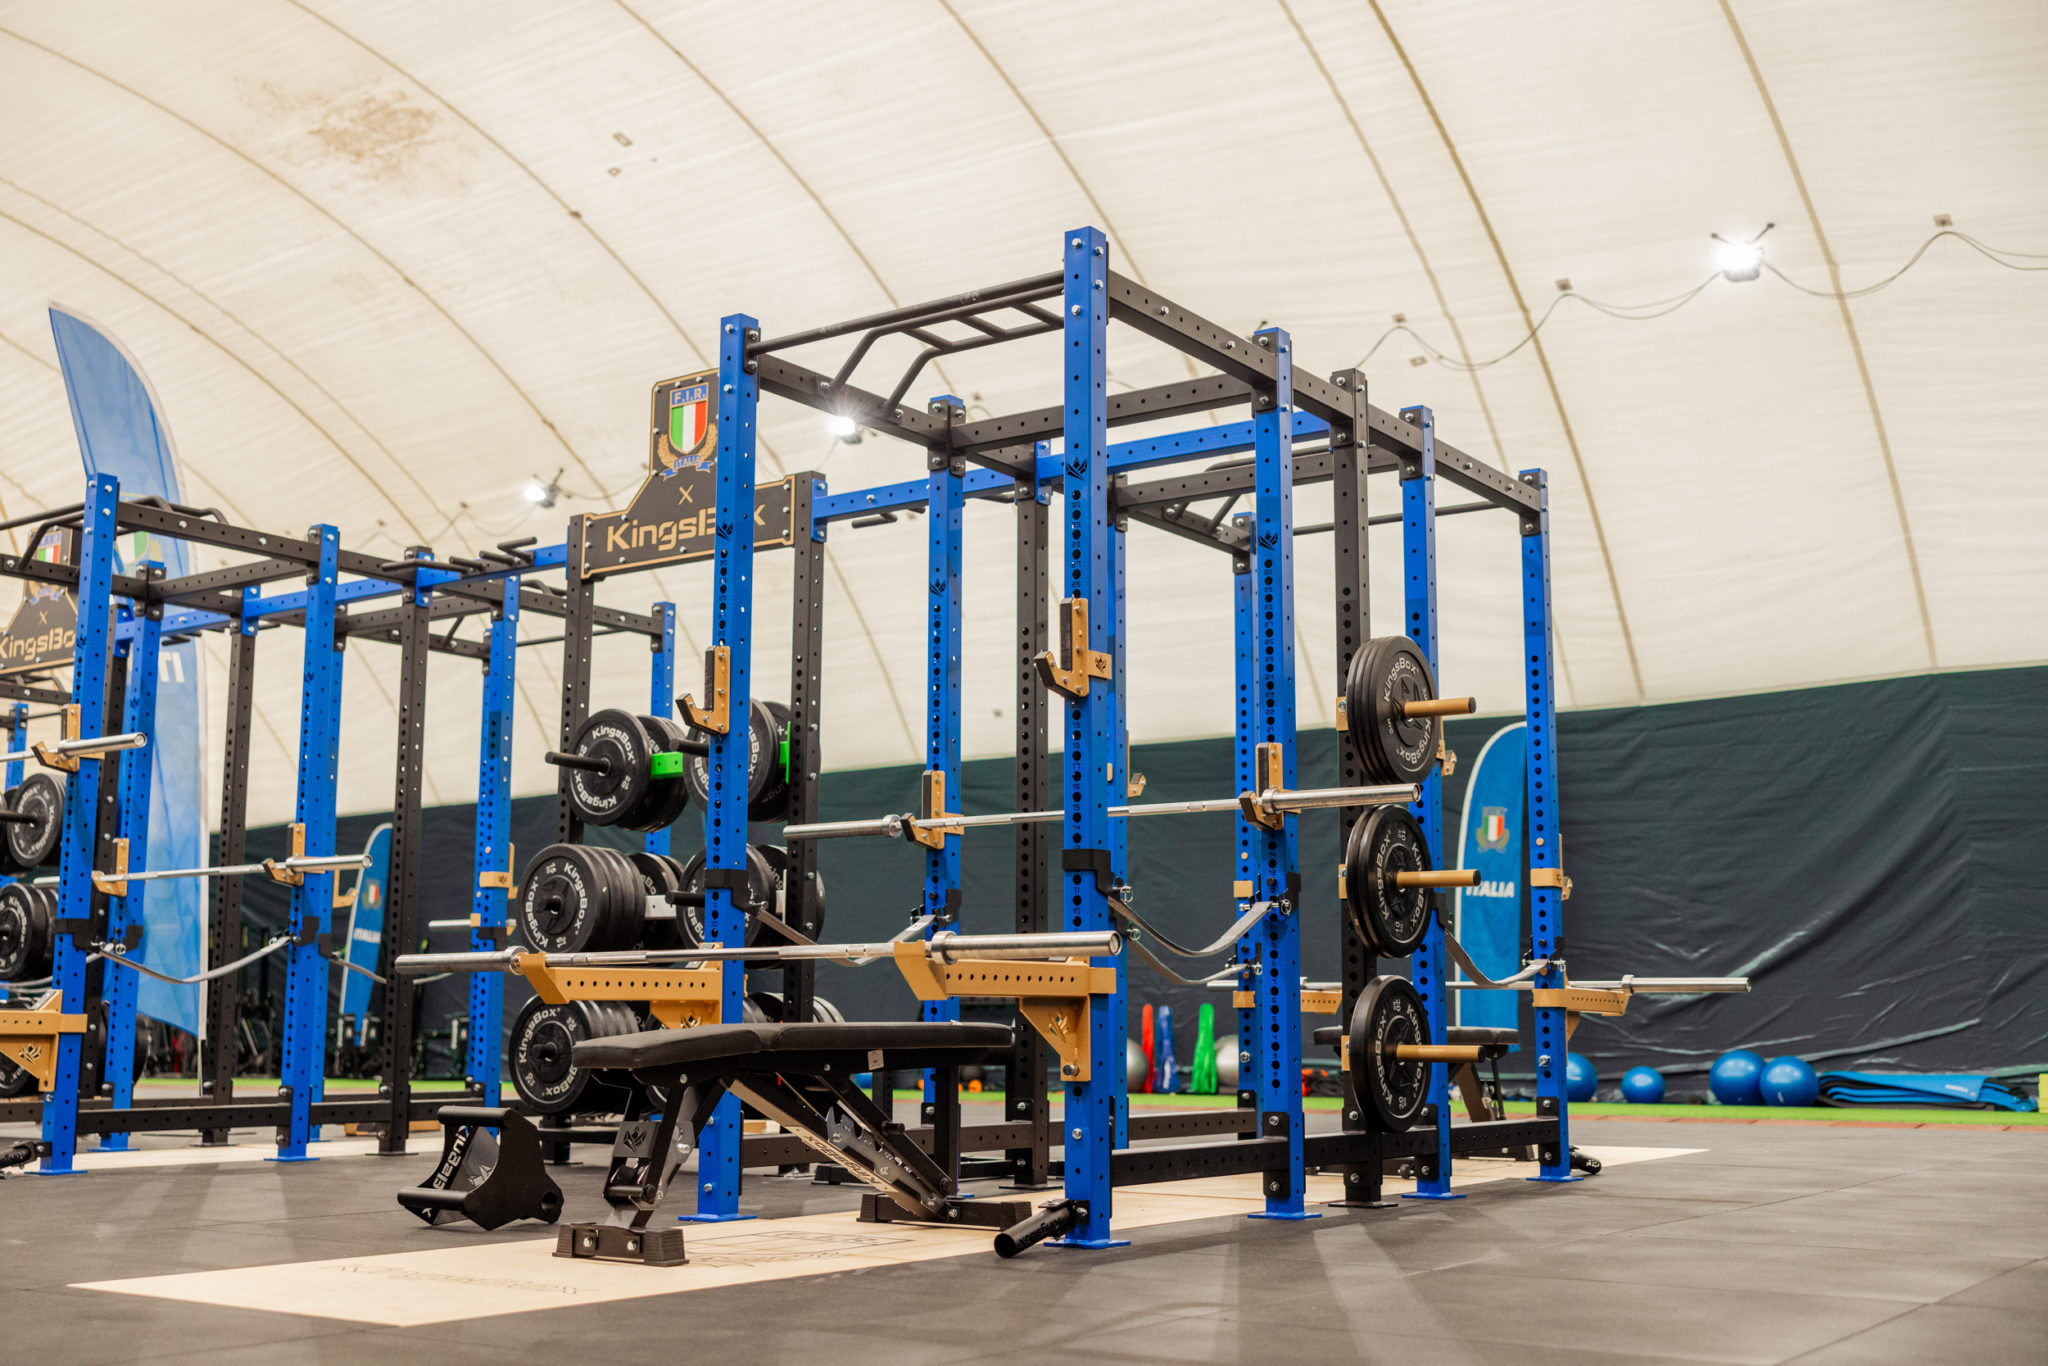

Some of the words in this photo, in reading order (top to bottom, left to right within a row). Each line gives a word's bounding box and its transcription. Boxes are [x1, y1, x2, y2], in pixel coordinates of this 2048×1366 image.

[674, 387, 707, 404] F.I.R.
[607, 503, 767, 552] KingsBx
[1384, 657, 1417, 703] KingsBox
[545, 1065, 578, 1096] gsBox
